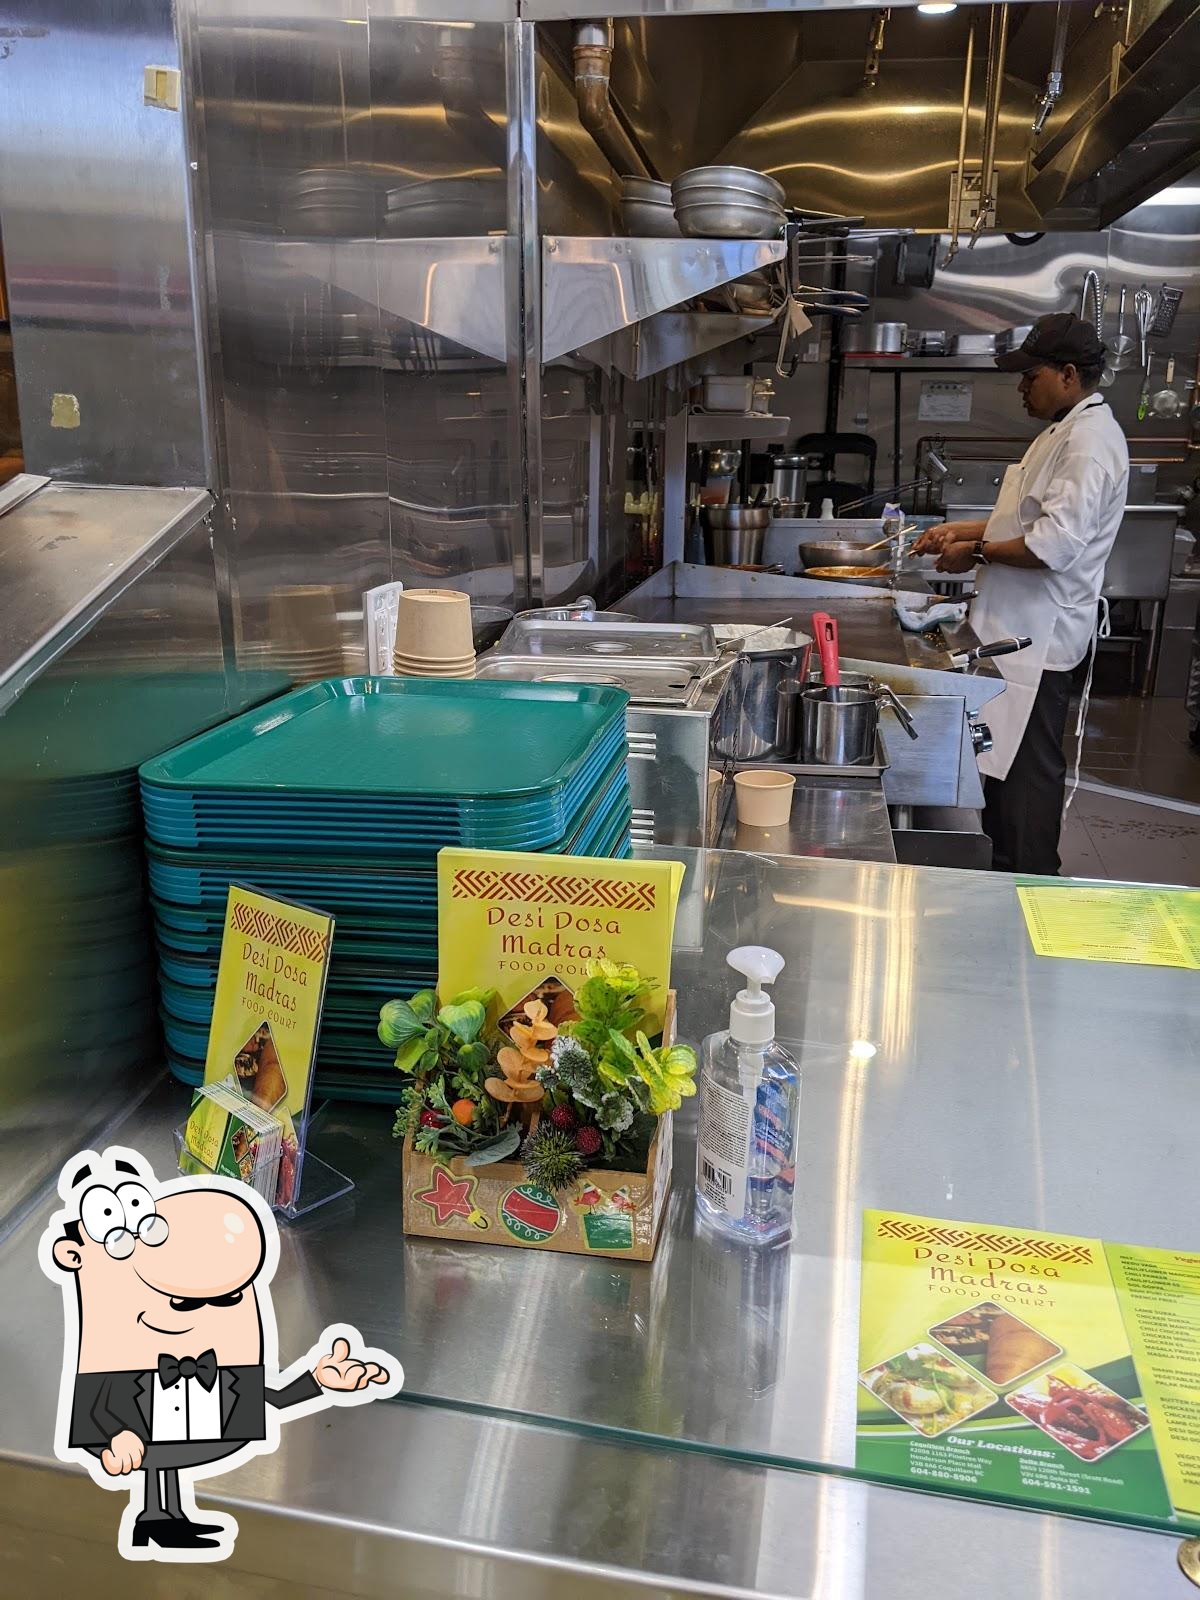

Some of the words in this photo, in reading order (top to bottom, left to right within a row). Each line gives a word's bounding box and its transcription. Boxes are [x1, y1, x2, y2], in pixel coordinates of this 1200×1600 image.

[486, 906, 544, 928] Desi
[554, 911, 621, 934] Dosa
[502, 933, 606, 960] Madras
[242, 942, 270, 970] Desi
[274, 955, 307, 986] Dosa
[498, 960, 546, 972] FOOD
[554, 963, 588, 976] COU
[246, 971, 296, 1012] Madras
[242, 997, 265, 1014] FOOD
[267, 1009, 297, 1030] COURT
[914, 1247, 975, 1267] Desi
[987, 1257, 1061, 1278] Dosa
[930, 1266, 1048, 1295] Madras
[928, 1284, 981, 1298] FOOD
[991, 1293, 1056, 1307] COURT
[947, 1436, 975, 1446] Our
[977, 1439, 1056, 1459] Locations:
